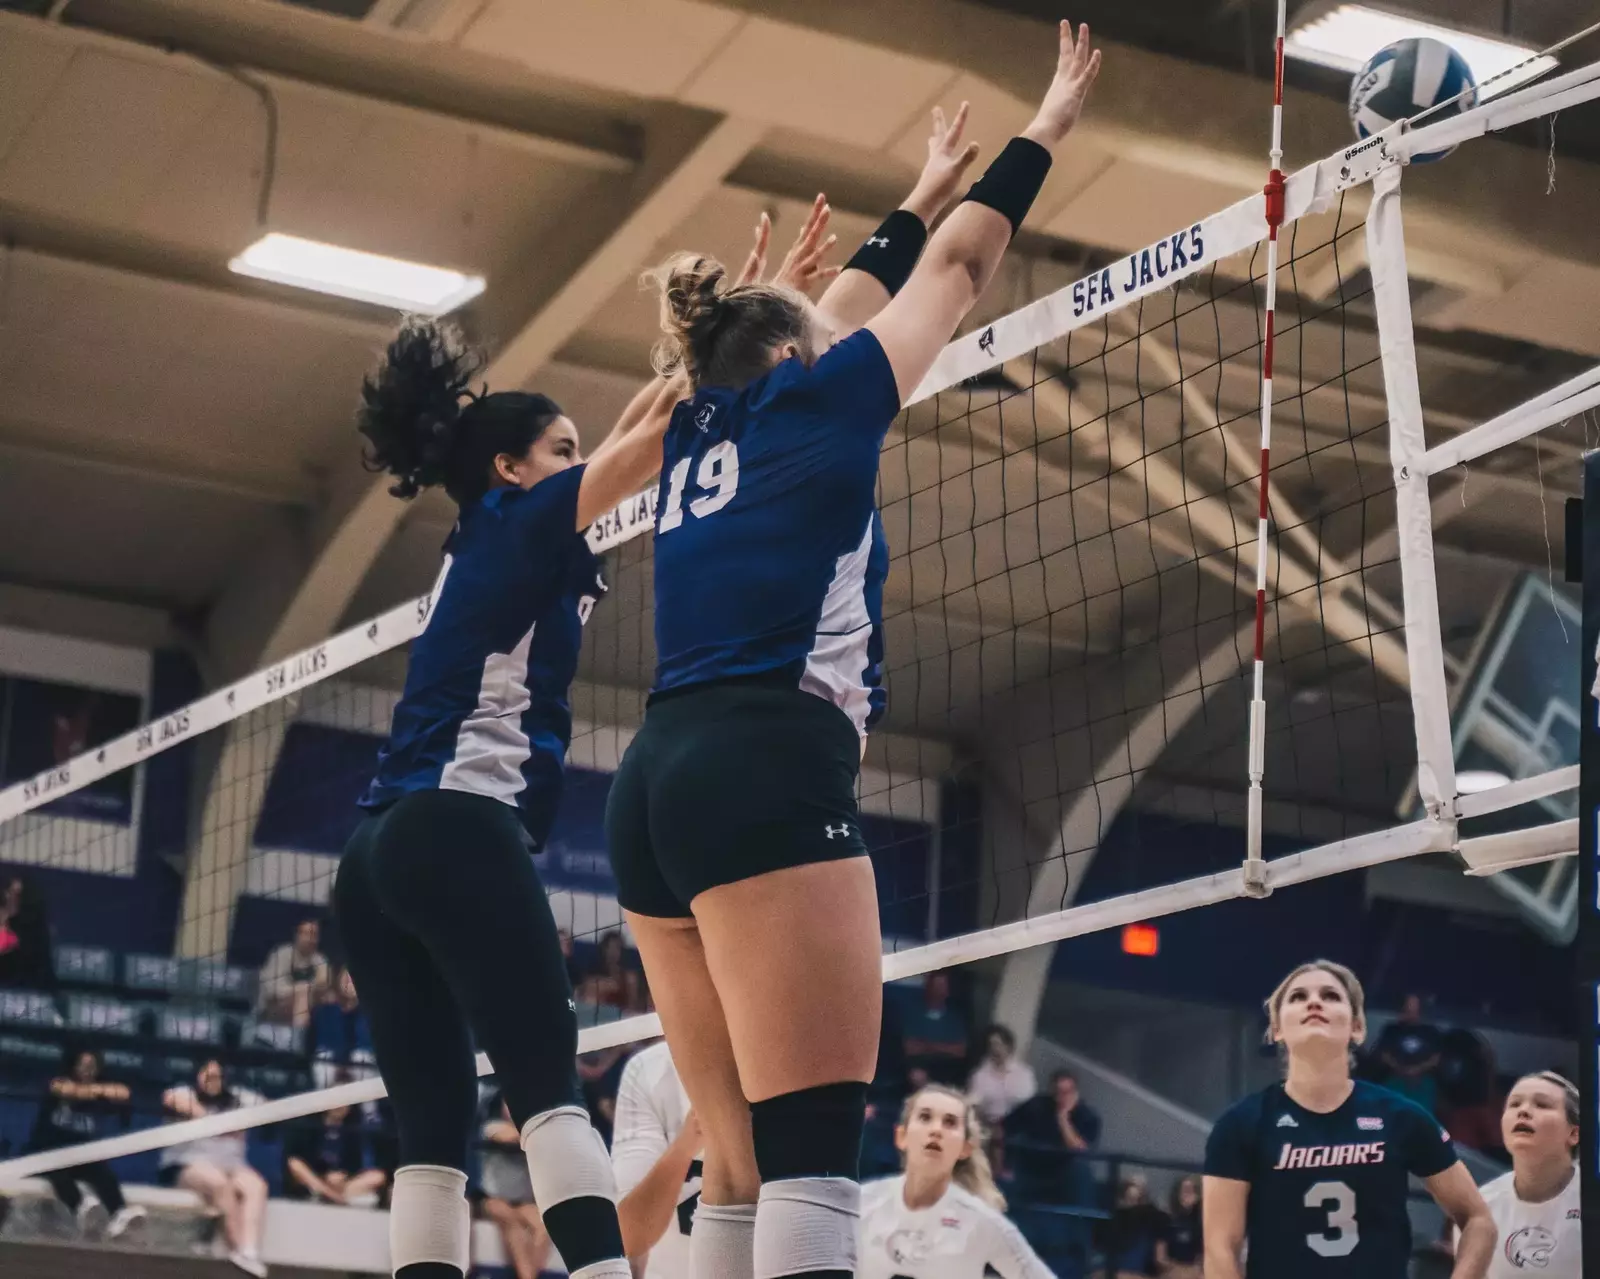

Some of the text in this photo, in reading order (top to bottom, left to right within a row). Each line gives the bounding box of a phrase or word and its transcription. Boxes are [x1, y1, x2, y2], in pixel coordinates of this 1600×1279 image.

[1350, 135, 1384, 157] Senoh
[1073, 223, 1204, 317] SFA JACKS
[659, 440, 740, 534] 19
[1273, 1141, 1386, 1170] JAGUARS
[1304, 1181, 1360, 1257] 3
